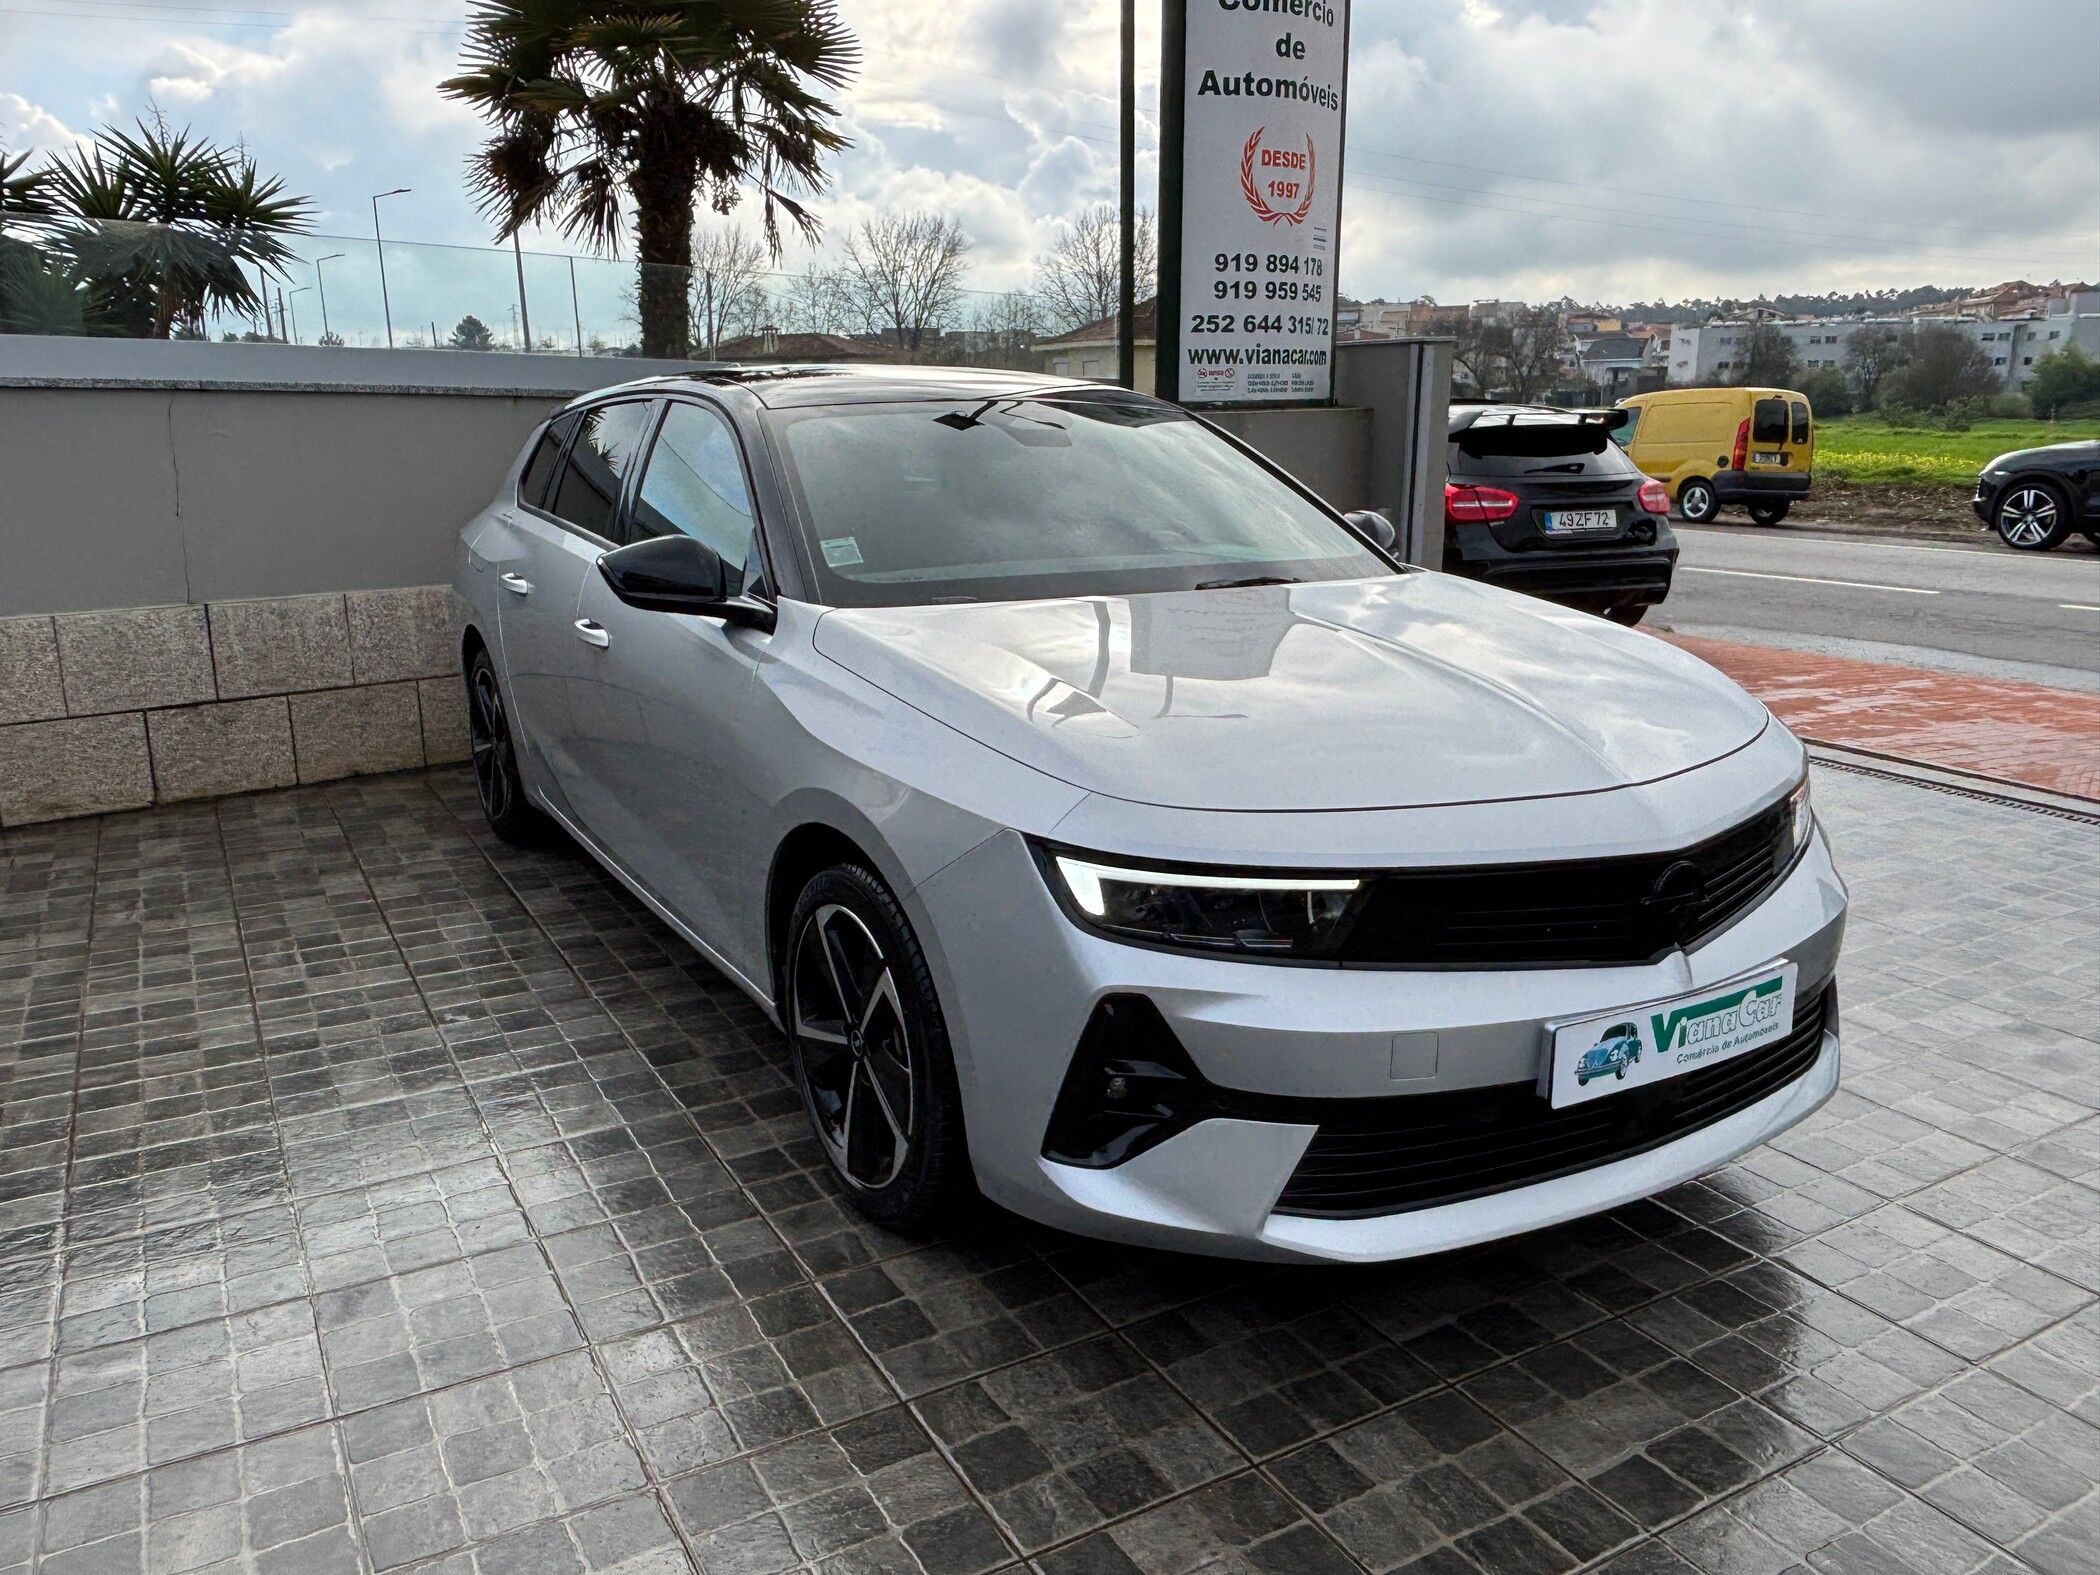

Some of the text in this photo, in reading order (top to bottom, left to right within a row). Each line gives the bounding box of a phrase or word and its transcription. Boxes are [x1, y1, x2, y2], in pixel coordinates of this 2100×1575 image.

[1275, 32, 1306, 60] de
[1197, 70, 1339, 111] Automóveis
[1261, 149, 1307, 171] DESDE
[1268, 180, 1301, 200] 1997
[1214, 253, 1323, 277] 919 894 178
[1213, 280, 1322, 302] 919 959 545
[1191, 314, 1235, 333] 252
[1243, 314, 1283, 333] 644
[1188, 343, 1327, 366] www.vianacar.com
